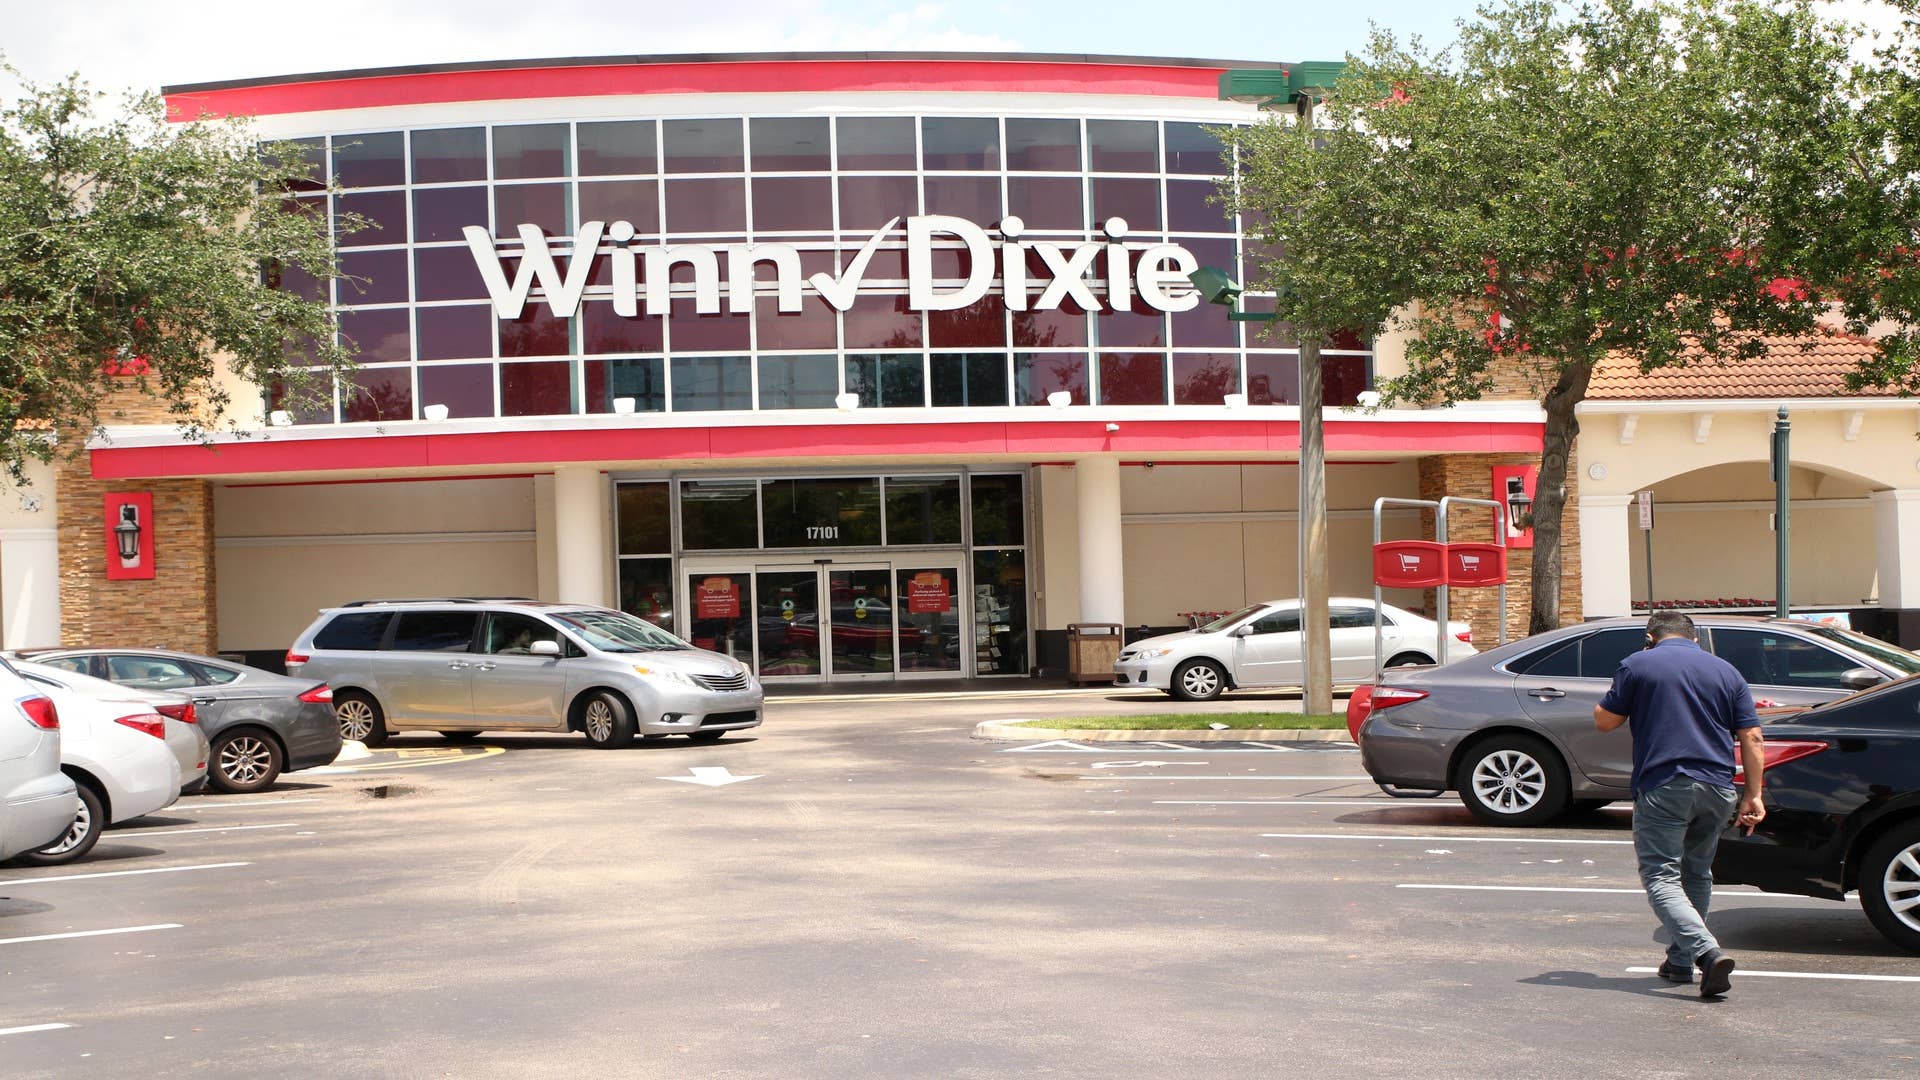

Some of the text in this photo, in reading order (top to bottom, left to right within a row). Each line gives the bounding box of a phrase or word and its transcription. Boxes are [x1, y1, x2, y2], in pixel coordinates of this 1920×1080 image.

[463, 215, 1200, 319] Winn Dixie
[806, 526, 839, 539] 17101
